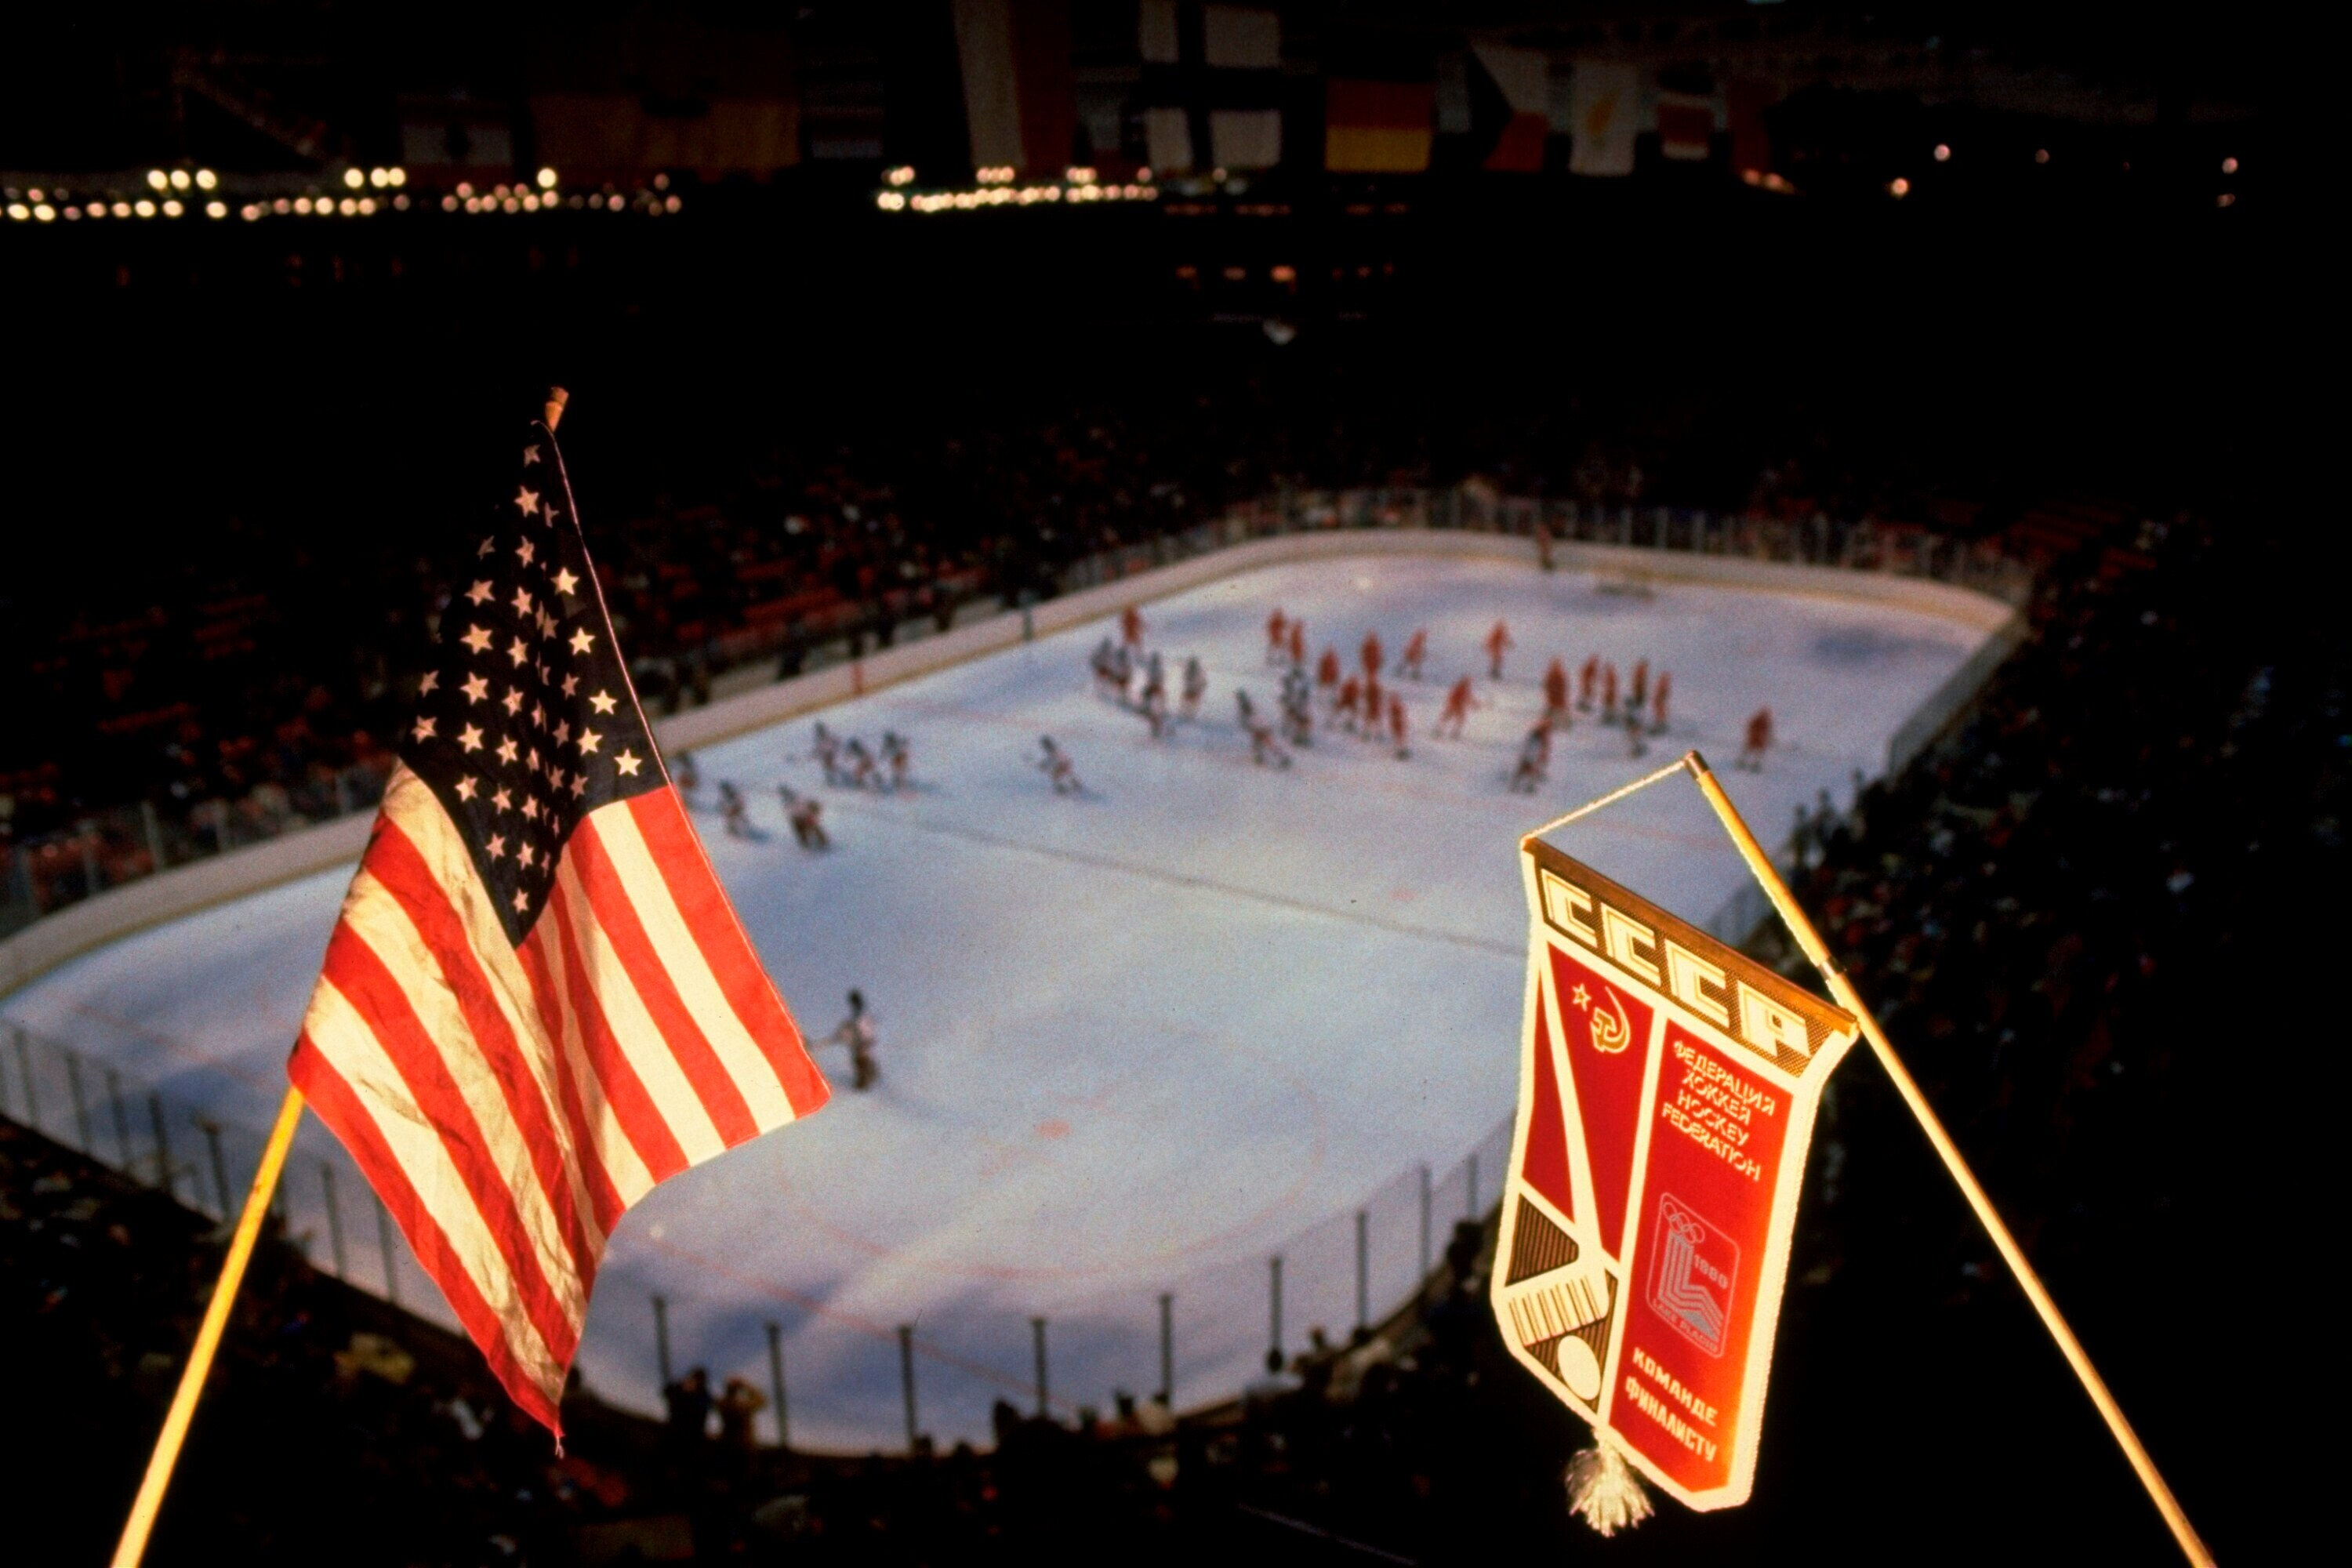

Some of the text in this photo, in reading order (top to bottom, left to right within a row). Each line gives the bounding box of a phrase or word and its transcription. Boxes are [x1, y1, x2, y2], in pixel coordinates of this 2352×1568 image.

[1541, 868, 1811, 1058] СССР
[1673, 1040, 1776, 1116] ФЕДЕРАЦИЯ
[1682, 1069, 1751, 1126] ХОККЕЯ
[1677, 1088, 1749, 1146] HOCKEY
[1694, 1254, 1729, 1290] 1980
[1625, 1376, 1717, 1462] ФИНАЛИСТУ
[1632, 1346, 1719, 1427] КОМАНДЕ
